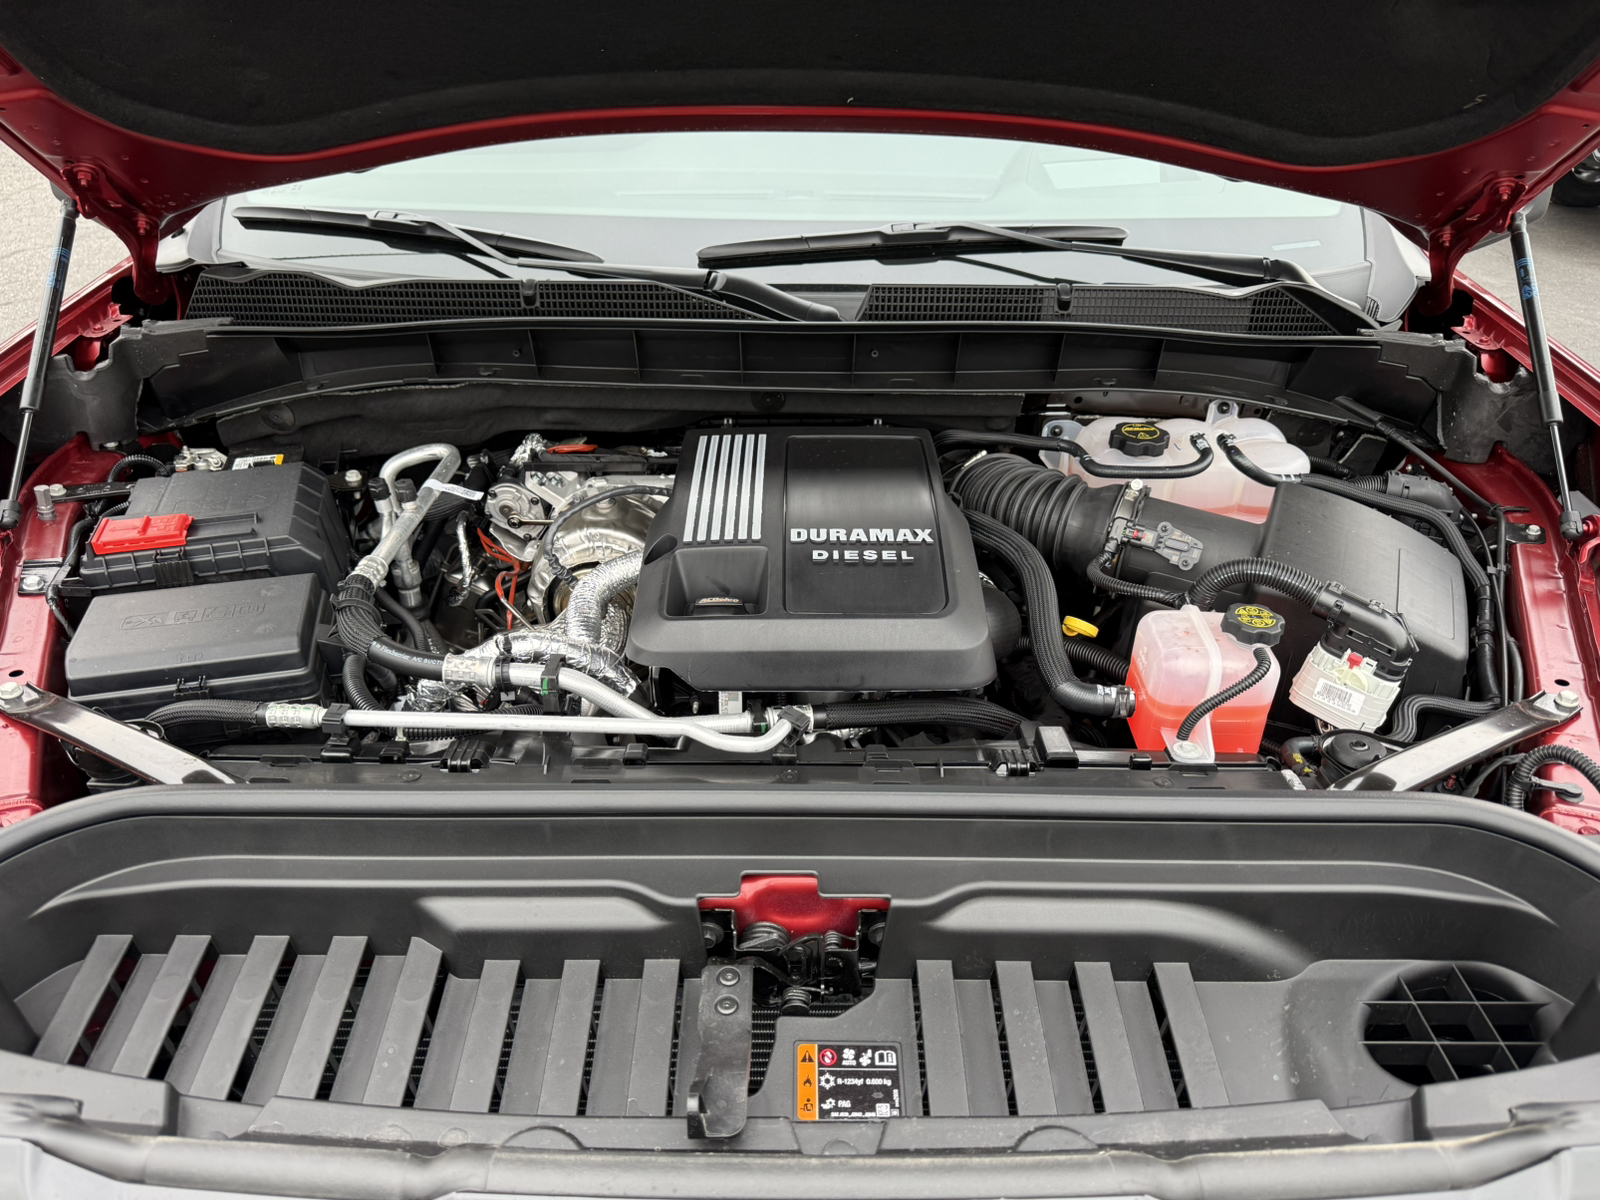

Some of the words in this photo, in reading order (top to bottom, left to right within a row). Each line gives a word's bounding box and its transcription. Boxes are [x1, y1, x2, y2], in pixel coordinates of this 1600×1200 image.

[790, 528, 934, 545] DURAMAX
[812, 549, 915, 563] DIESEL
[837, 1078, 863, 1086] R-1234yf
[883, 1078, 892, 1086] kg
[838, 1100, 851, 1108] PAG
